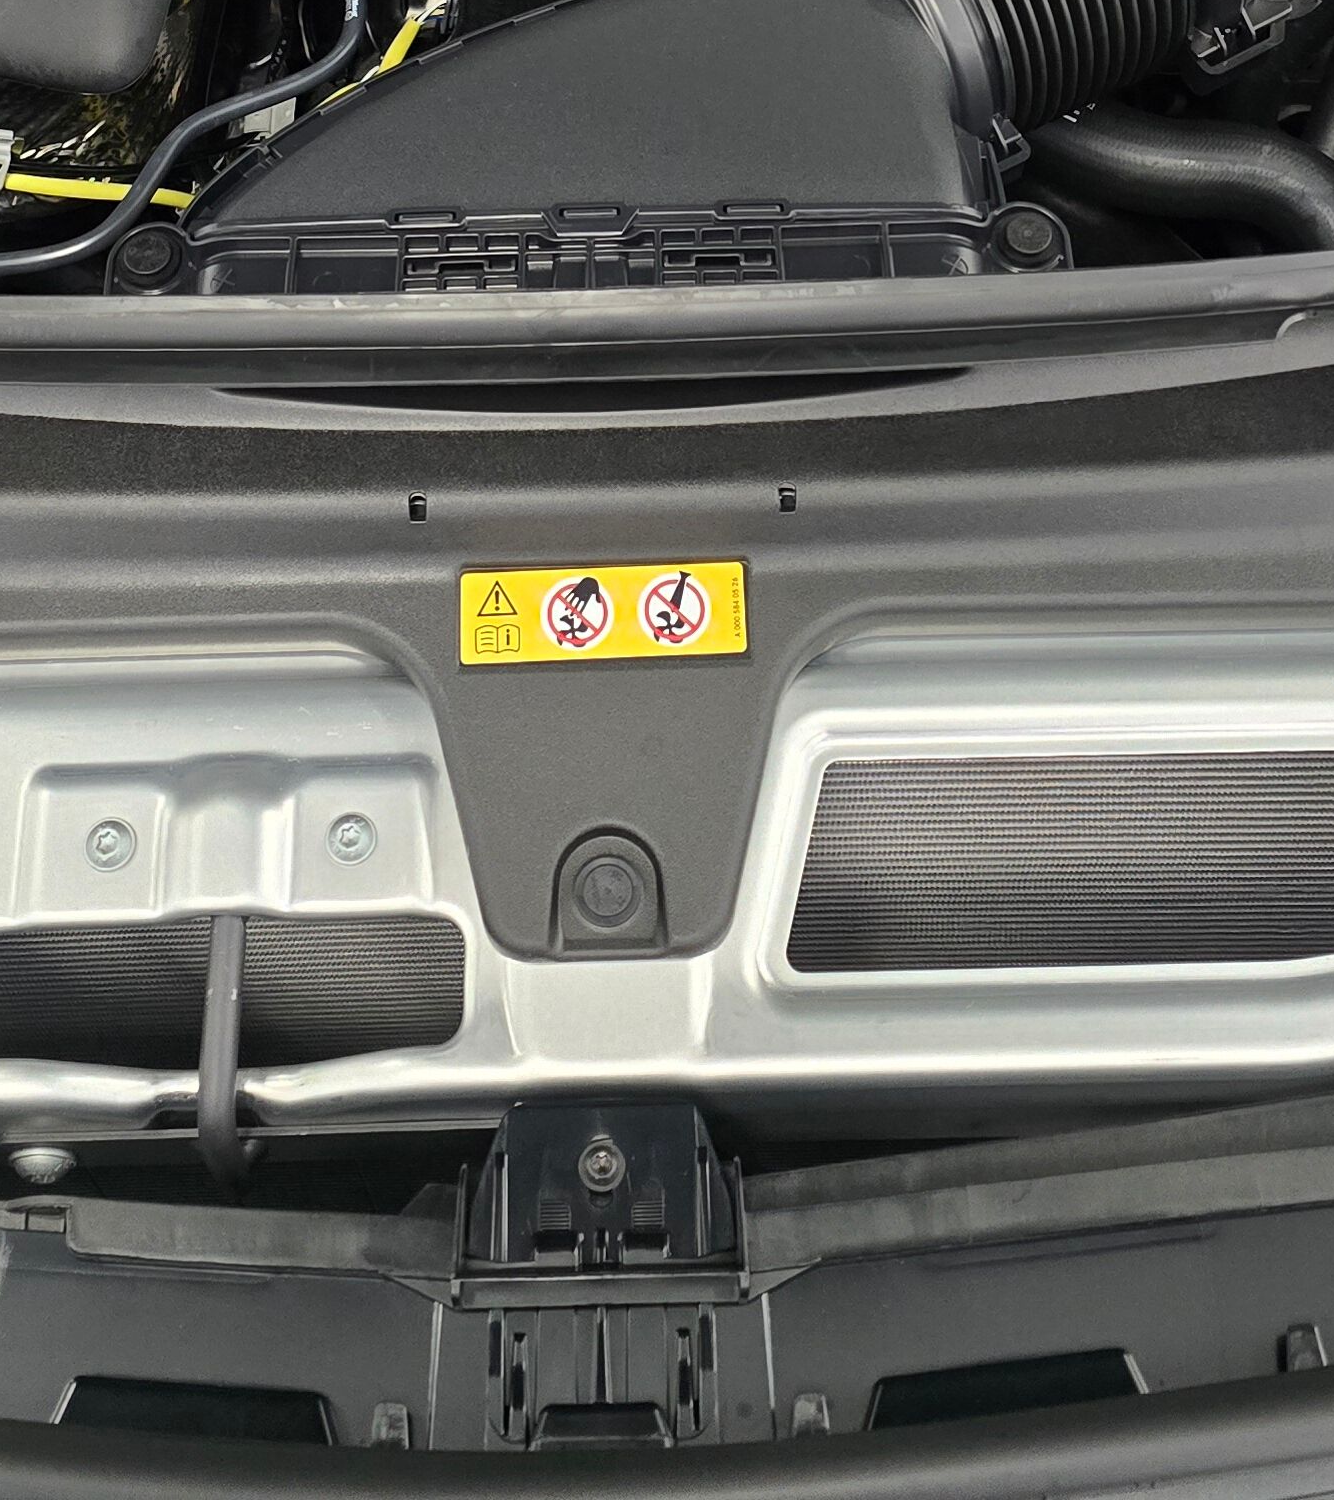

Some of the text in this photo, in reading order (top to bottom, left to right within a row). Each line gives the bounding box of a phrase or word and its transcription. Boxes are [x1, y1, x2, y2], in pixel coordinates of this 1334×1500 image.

[731, 577, 739, 587] 26
[732, 589, 739, 598] 05
[733, 616, 741, 630] 000
